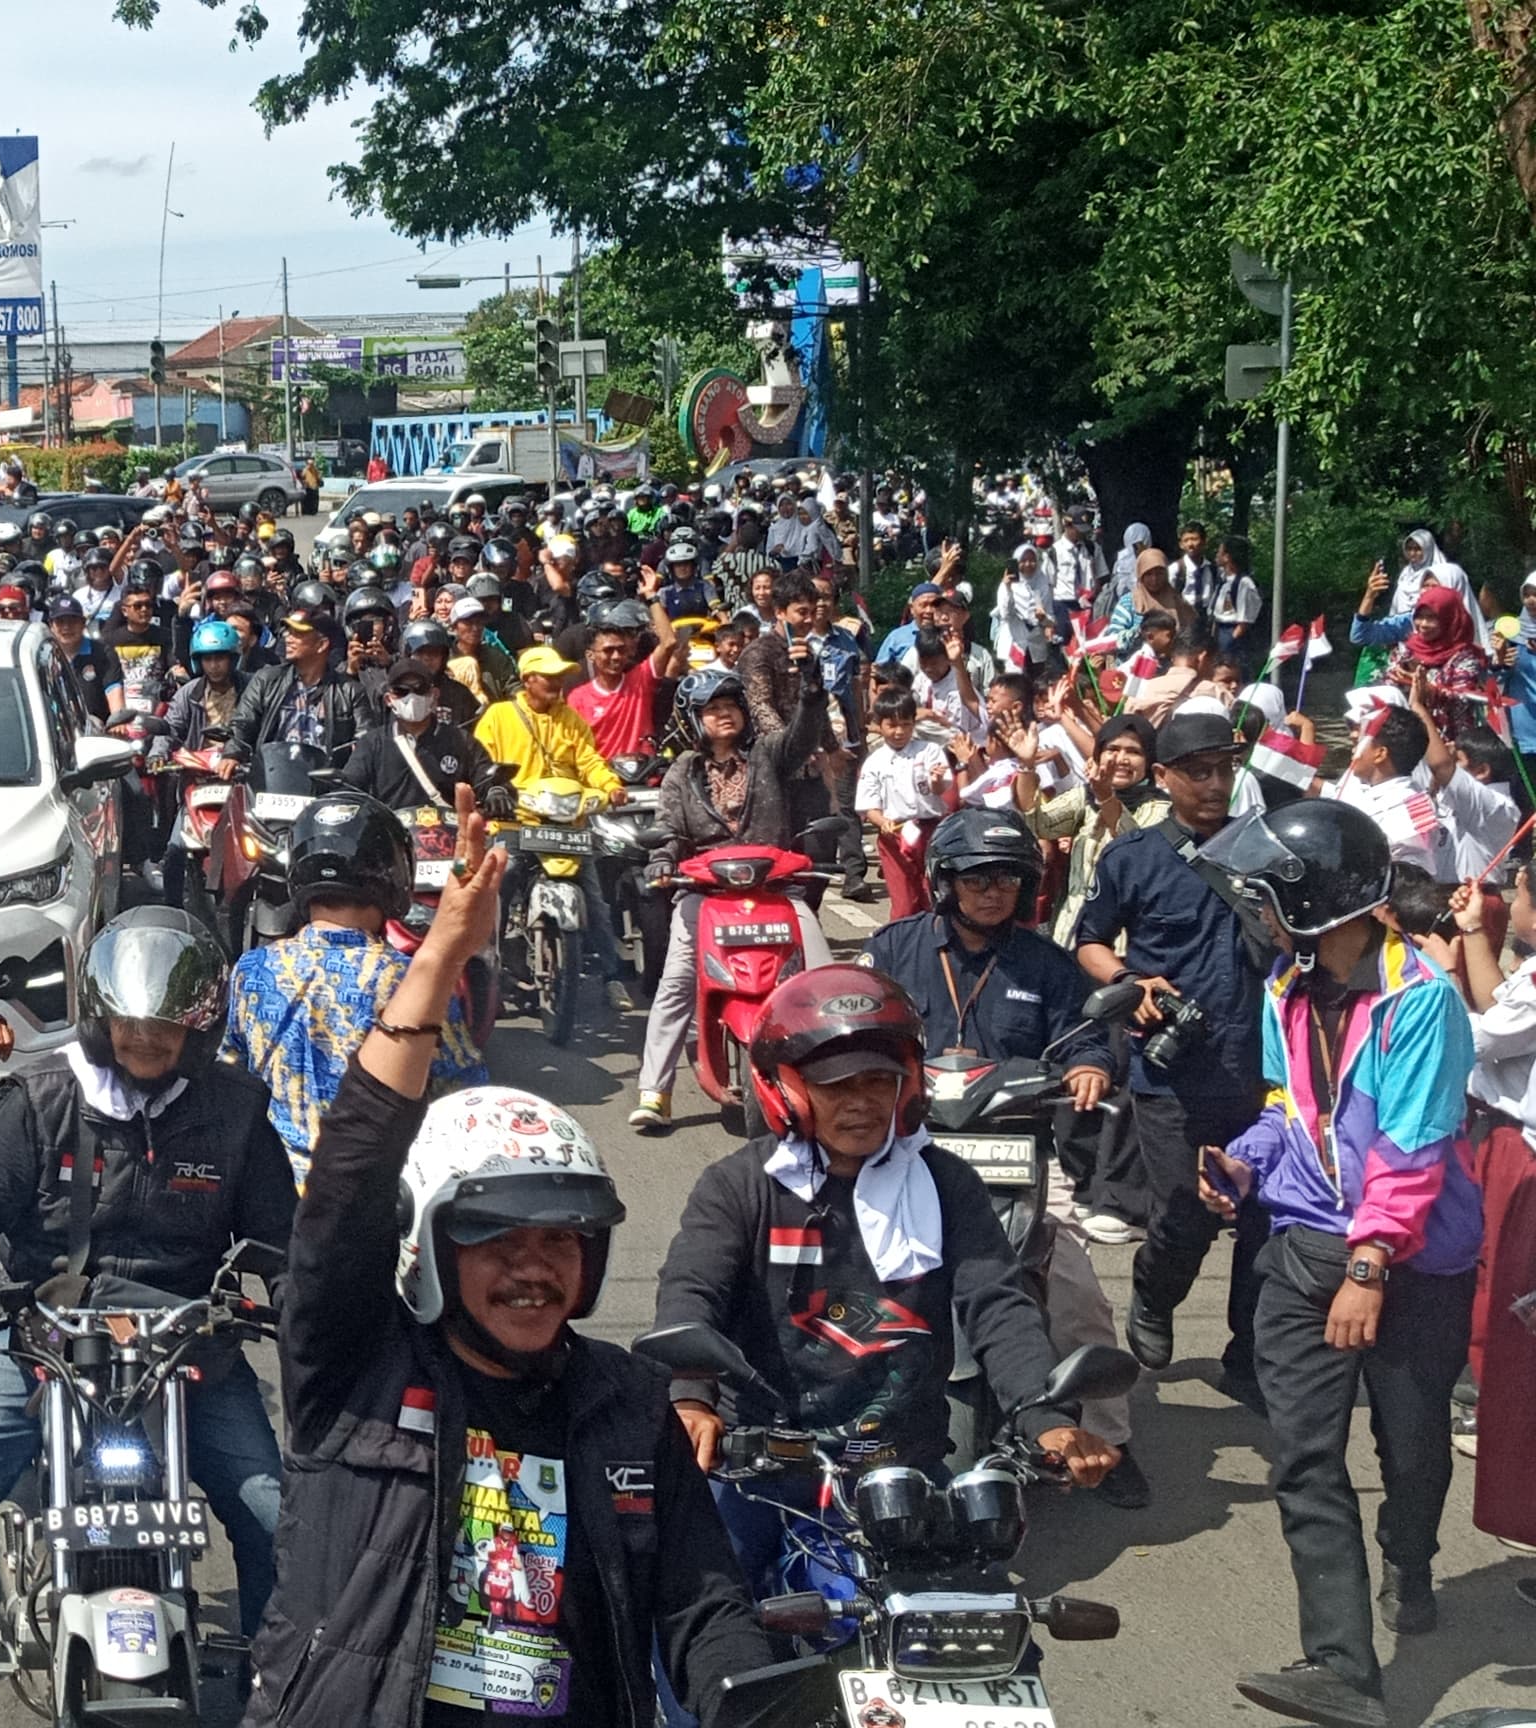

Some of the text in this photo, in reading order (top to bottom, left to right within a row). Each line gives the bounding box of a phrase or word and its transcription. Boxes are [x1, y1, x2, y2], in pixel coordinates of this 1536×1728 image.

[16, 304, 40, 331] 800
[415, 351, 448, 362] RAJA
[384, 364, 455, 377] RG GADAI
[48, 1502, 202, 1530] B 6875 VVG
[850, 1677, 868, 1704] B
[984, 1680, 1040, 1707] VST
